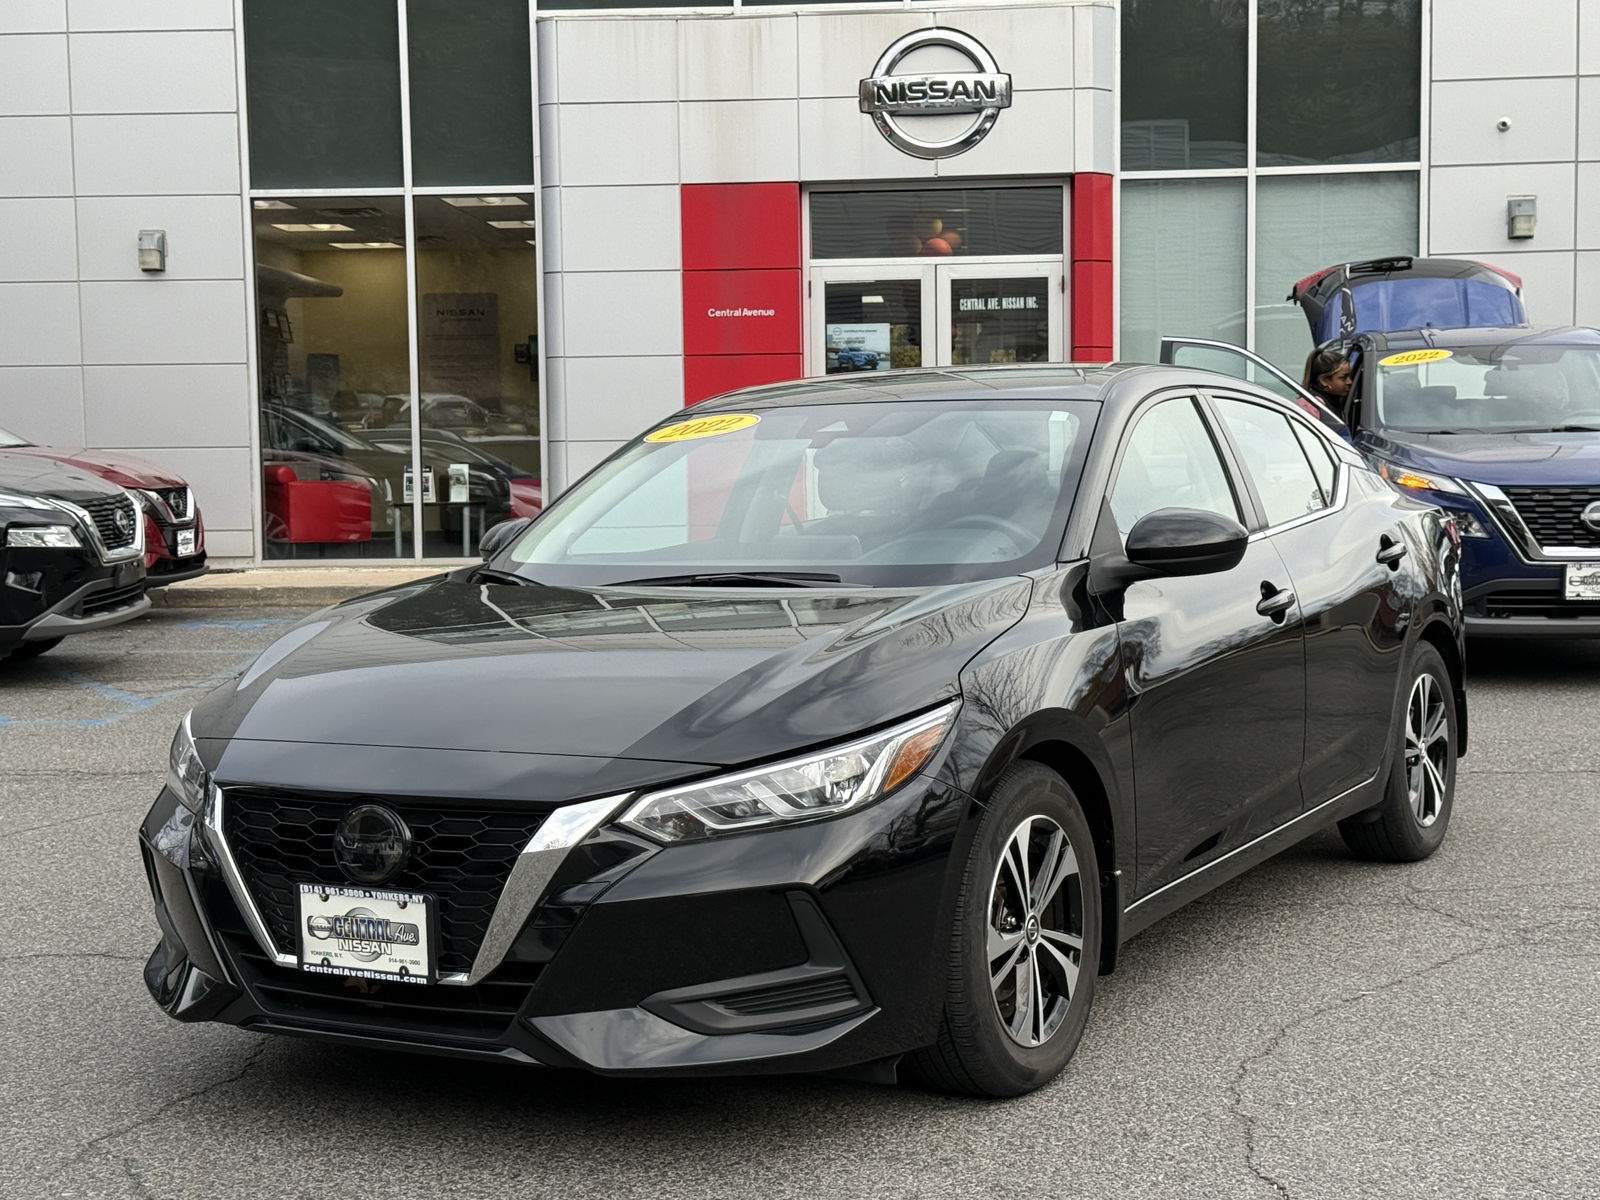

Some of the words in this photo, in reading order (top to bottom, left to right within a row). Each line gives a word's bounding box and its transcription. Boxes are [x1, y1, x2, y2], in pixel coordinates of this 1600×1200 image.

[874, 80, 996, 105] NISSAN
[707, 308, 741, 317] Central
[742, 308, 775, 316] Avenue
[960, 298, 986, 311] CENTRAL
[987, 298, 1000, 310] AVE.
[1002, 297, 1024, 309] NISSAN
[1026, 296, 1039, 309] INC.
[1393, 351, 1440, 364] 2022
[657, 417, 745, 440] 2022
[333, 916, 393, 943] CENTRAL
[394, 924, 417, 942] Ave.
[338, 939, 392, 955] NISSAN
[303, 964, 427, 984] CentralAveNissan.com
